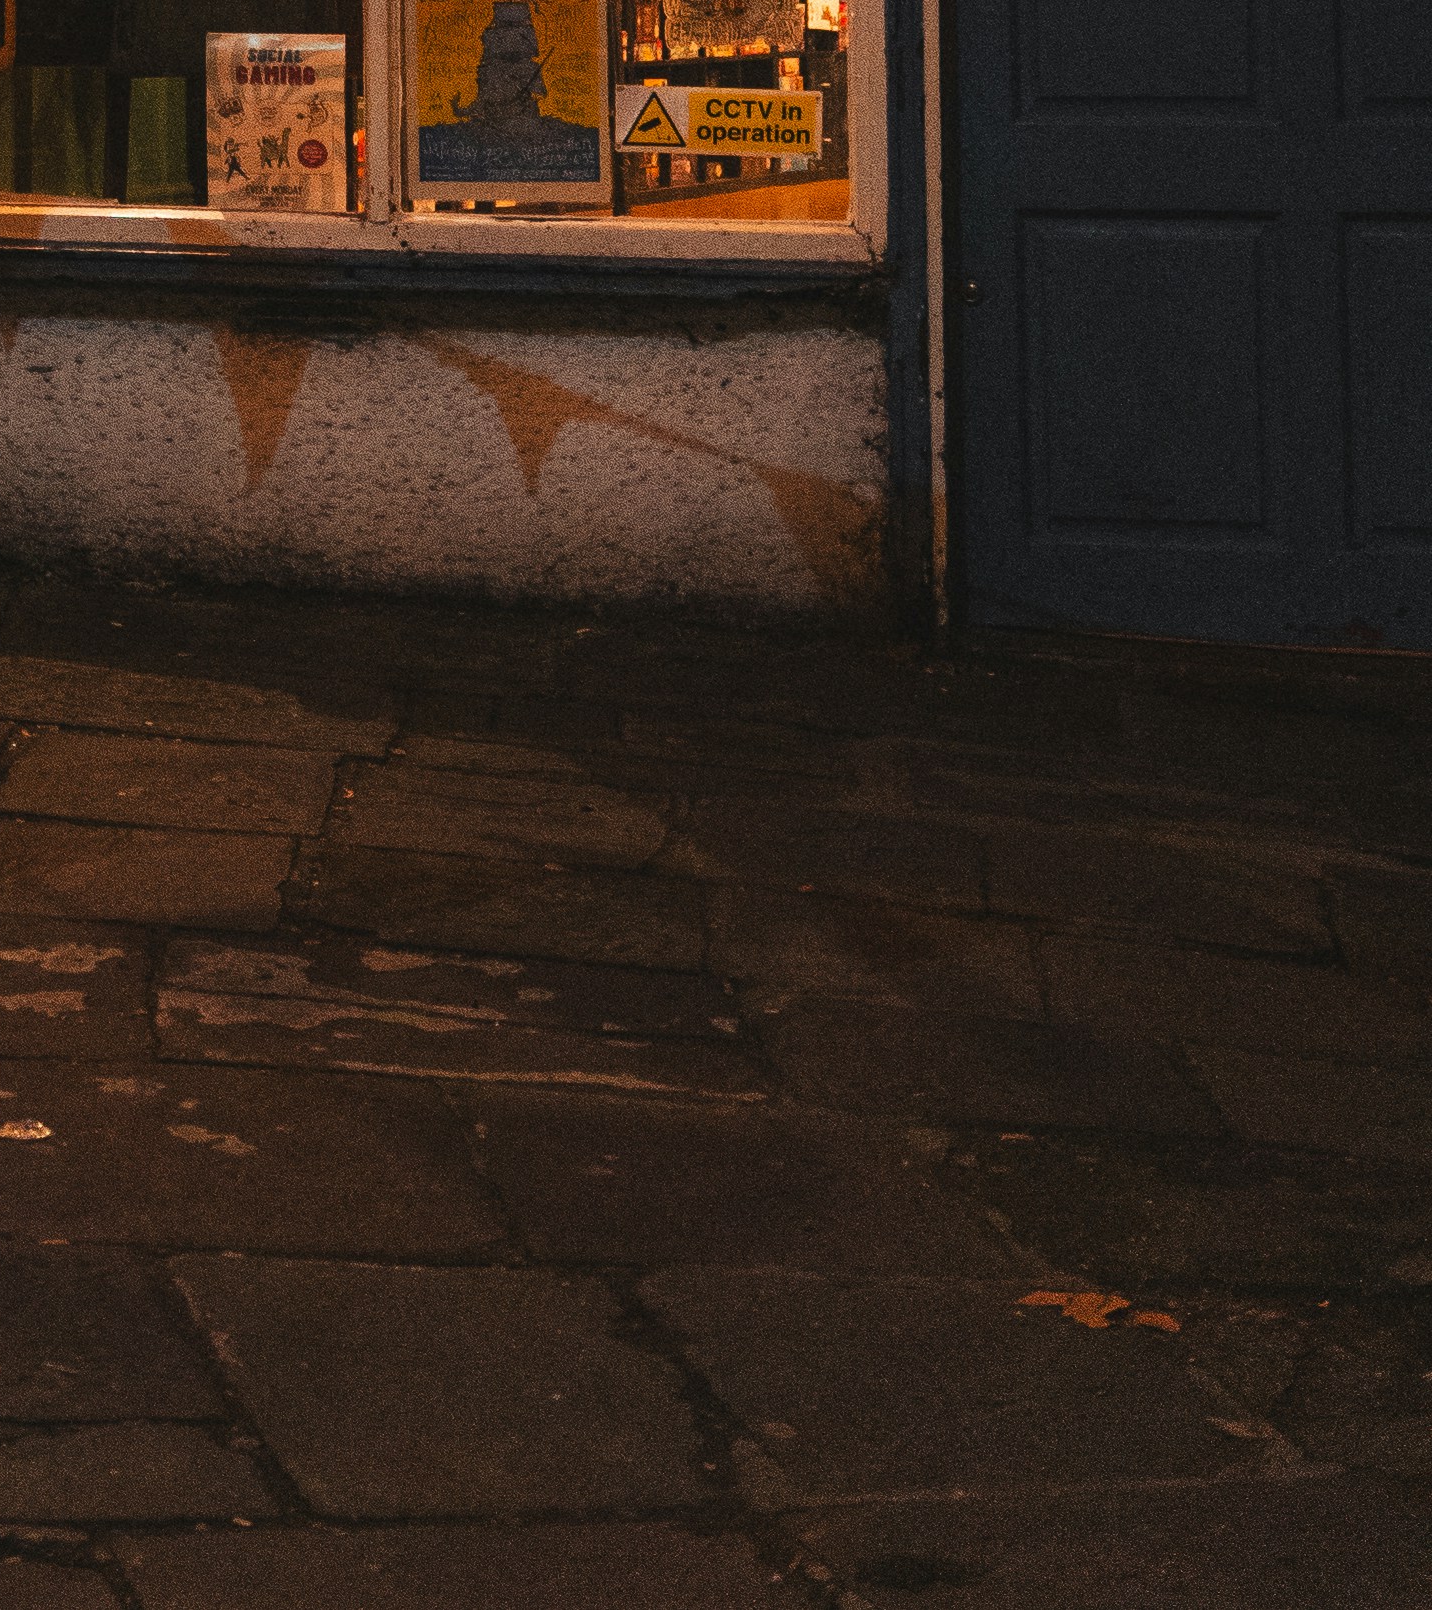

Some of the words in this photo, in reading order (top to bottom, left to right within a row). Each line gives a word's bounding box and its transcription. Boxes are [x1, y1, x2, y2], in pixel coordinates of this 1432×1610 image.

[236, 66, 316, 86] GAMING
[705, 98, 773, 119] CCTV
[781, 100, 802, 120] in
[696, 122, 811, 145] operation
